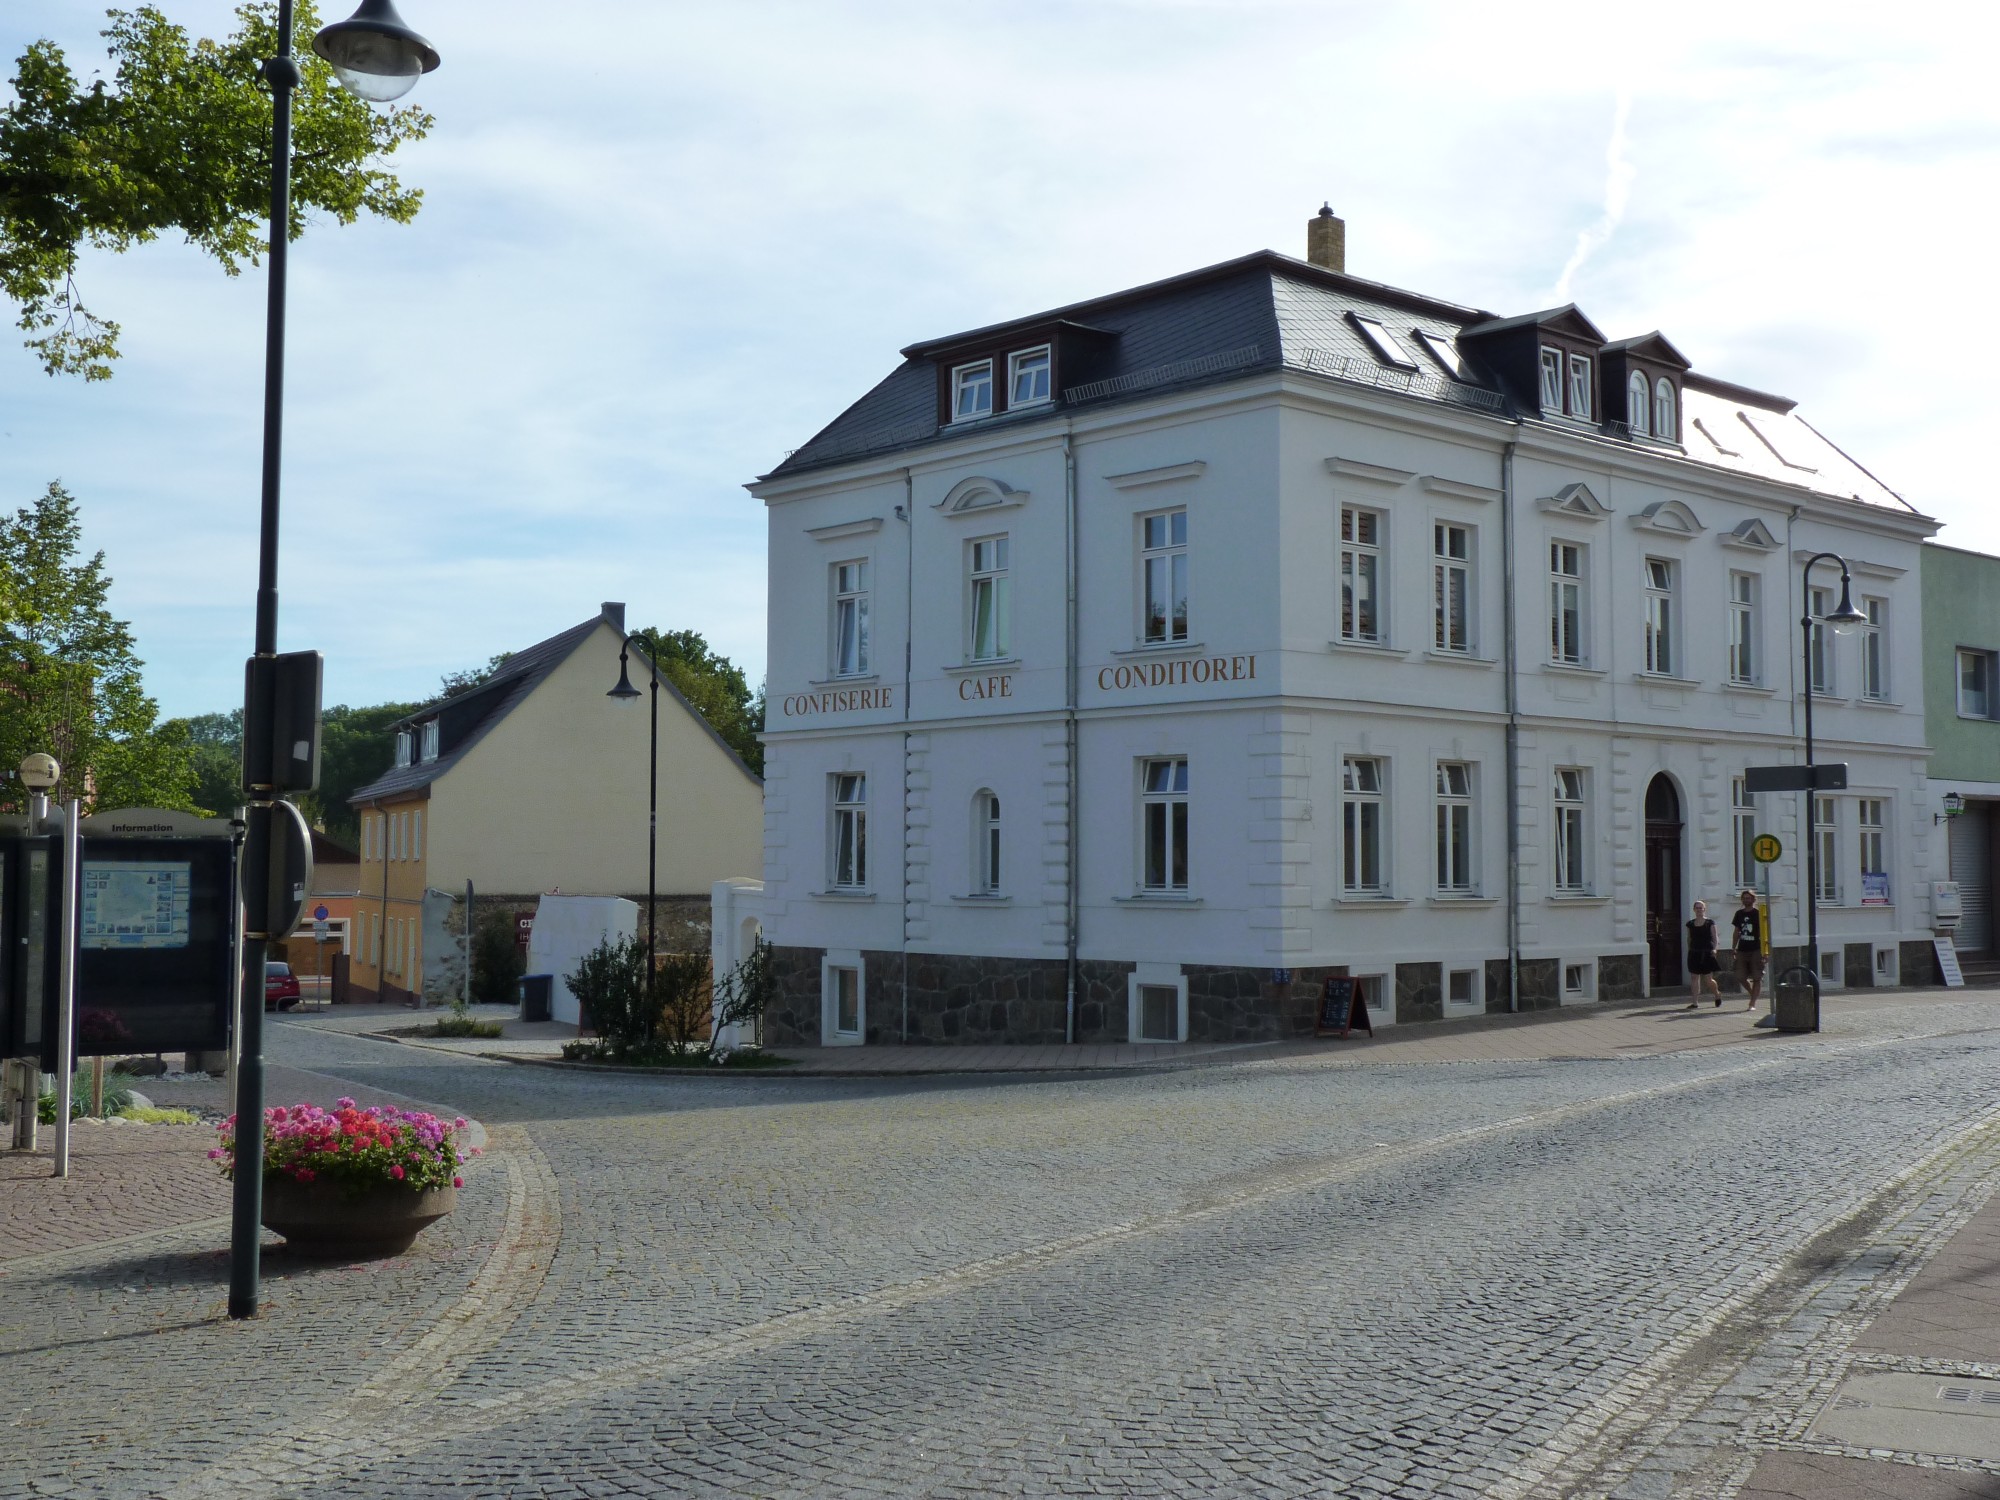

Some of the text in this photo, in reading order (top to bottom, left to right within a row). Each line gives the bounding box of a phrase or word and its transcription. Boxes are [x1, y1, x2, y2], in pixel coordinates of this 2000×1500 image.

[1098, 655, 1257, 691] CONDITOREI
[958, 675, 1013, 701] CAFE
[783, 687, 893, 717] CONFISERIE
[111, 823, 174, 833] Information
[1759, 840, 1774, 858] H
